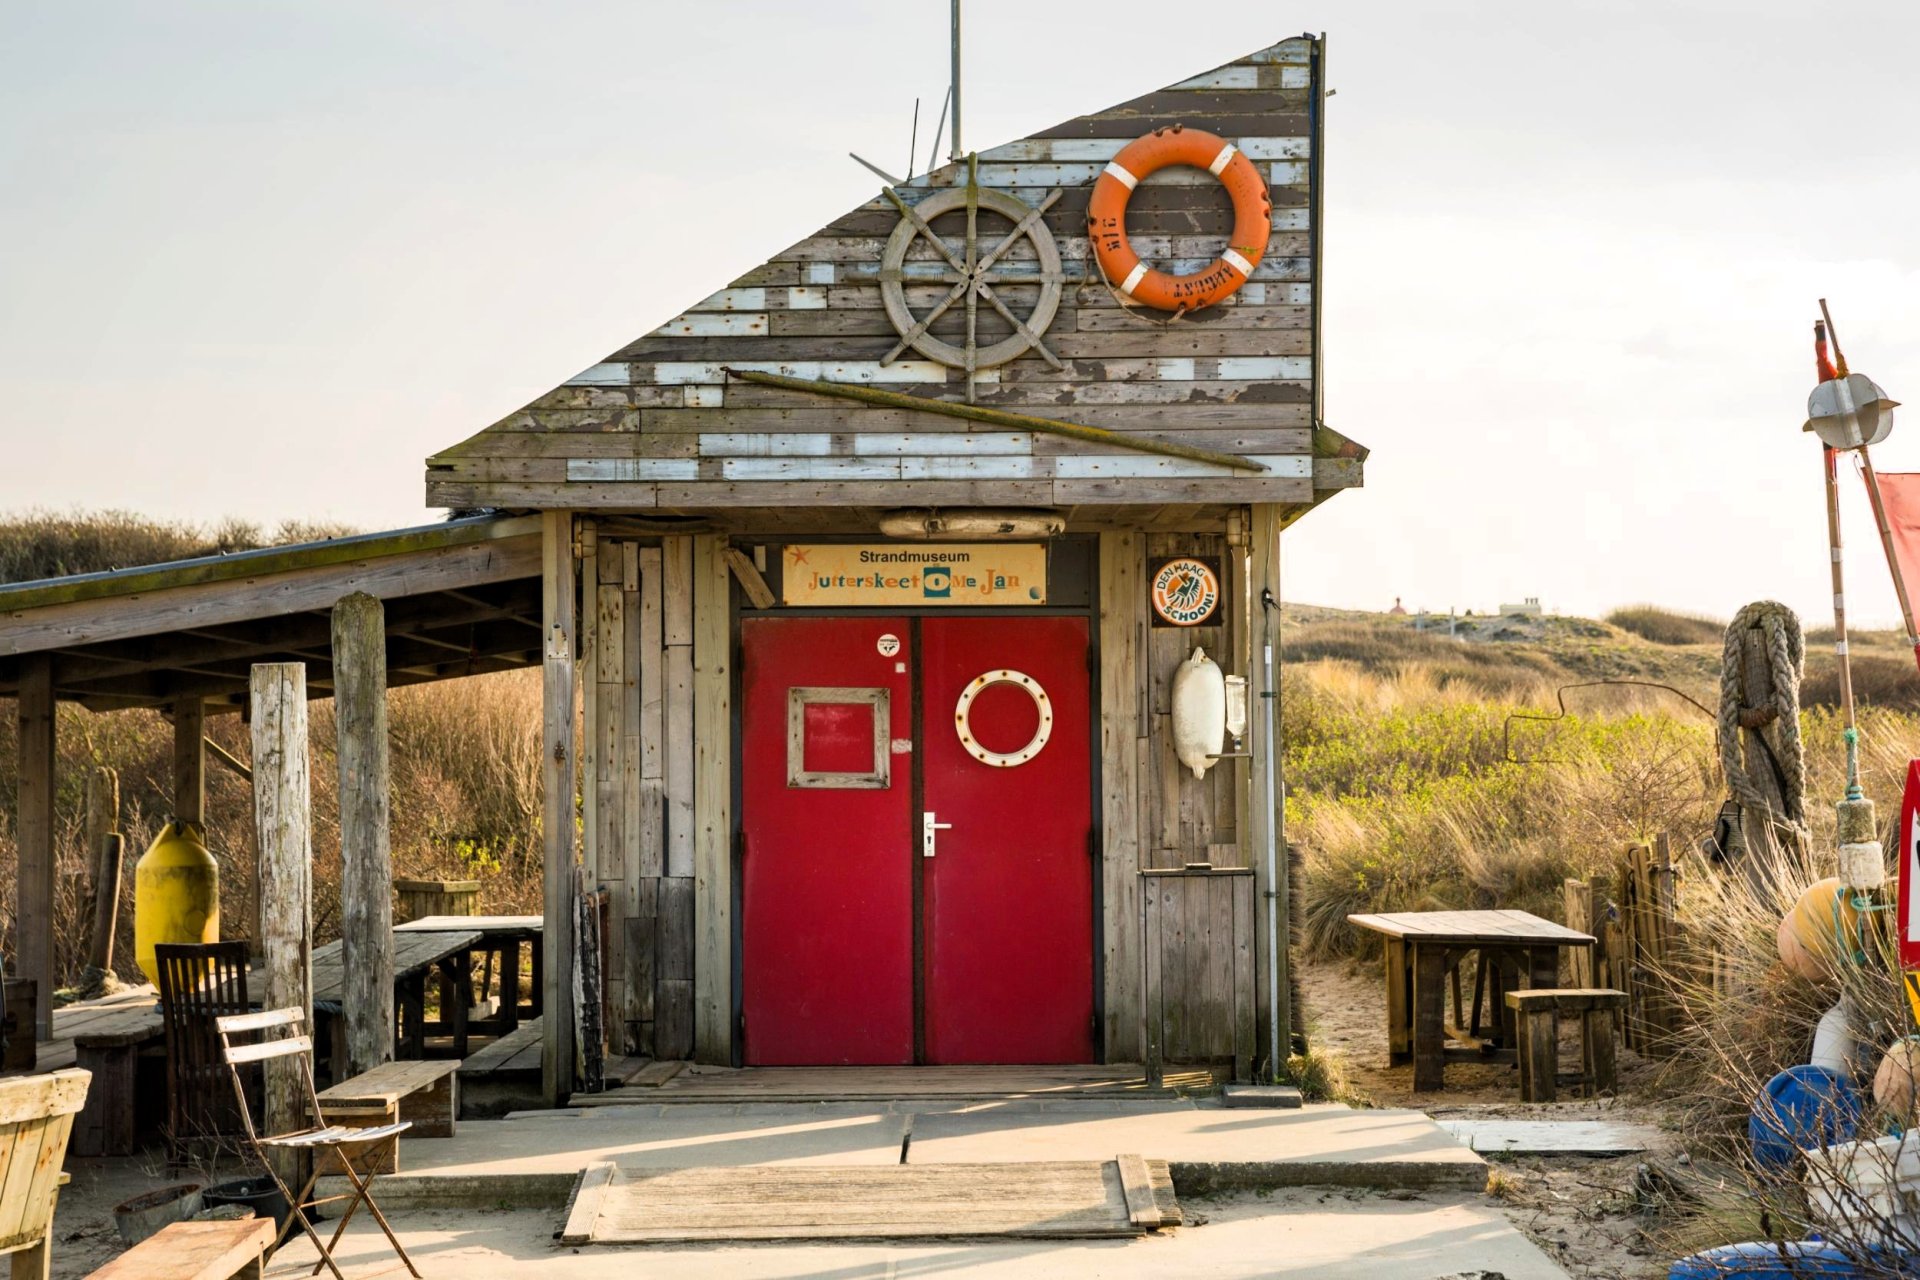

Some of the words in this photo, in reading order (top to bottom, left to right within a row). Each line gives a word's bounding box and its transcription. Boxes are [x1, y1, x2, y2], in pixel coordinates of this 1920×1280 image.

[860, 550, 971, 564] Strandmuseum
[808, 571, 920, 591] Jutterskeet
[980, 568, 1020, 595] Jan
[1157, 568, 1174, 590] DEN
[1174, 563, 1206, 577] HAAG
[1163, 593, 1215, 621] SCHOON!
